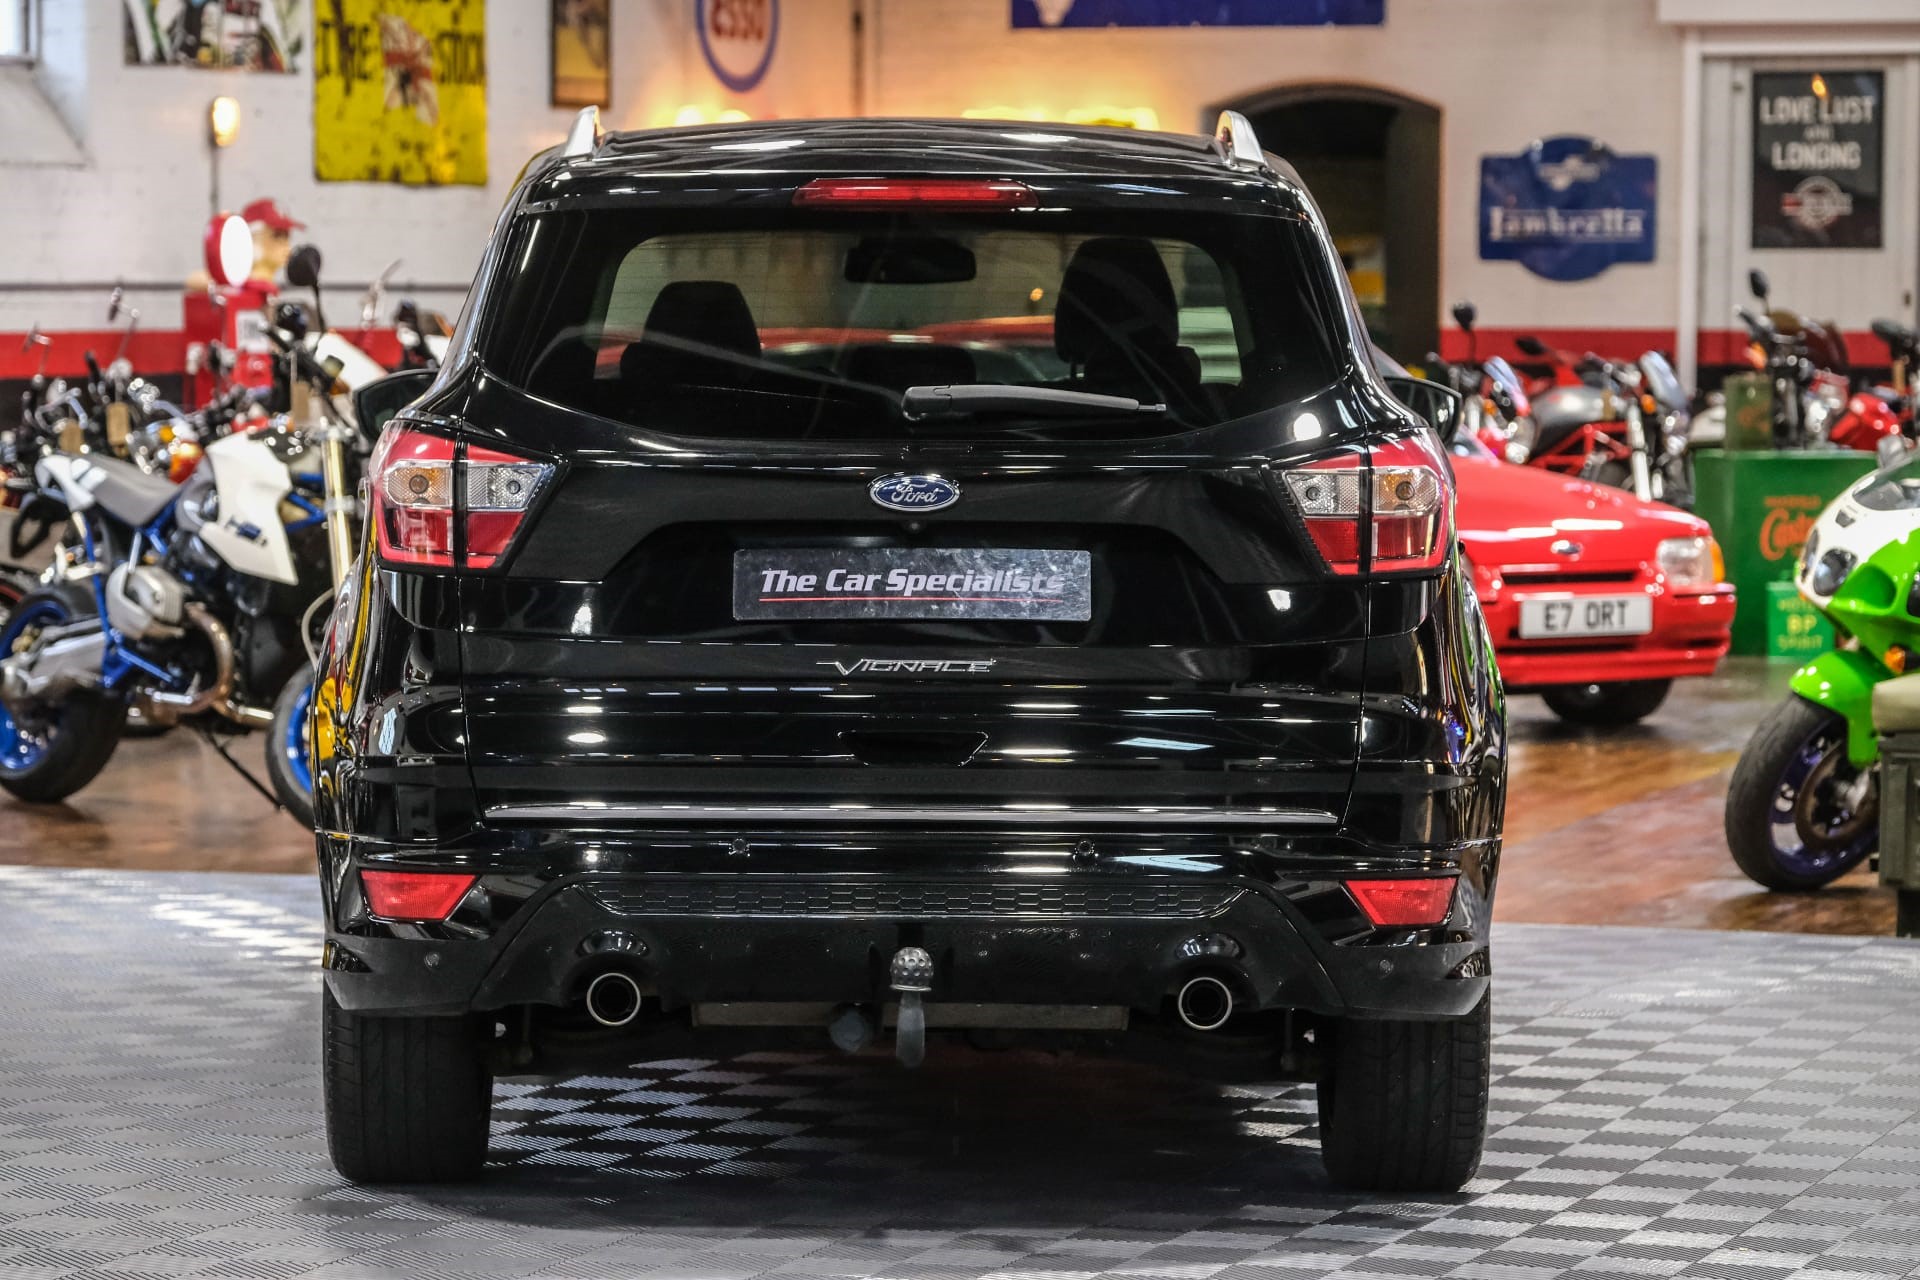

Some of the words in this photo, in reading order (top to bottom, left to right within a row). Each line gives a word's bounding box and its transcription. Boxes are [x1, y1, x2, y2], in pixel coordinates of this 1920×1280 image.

[1759, 96, 1815, 124] LOVE
[1818, 96, 1873, 124] LUST
[1771, 141, 1862, 170] LONGING
[762, 568, 817, 593] The
[825, 569, 881, 593] Car
[886, 569, 1064, 597] Specialists
[1544, 602, 1573, 631] E7
[1585, 600, 1629, 629] ORT
[1787, 614, 1817, 634] BP
